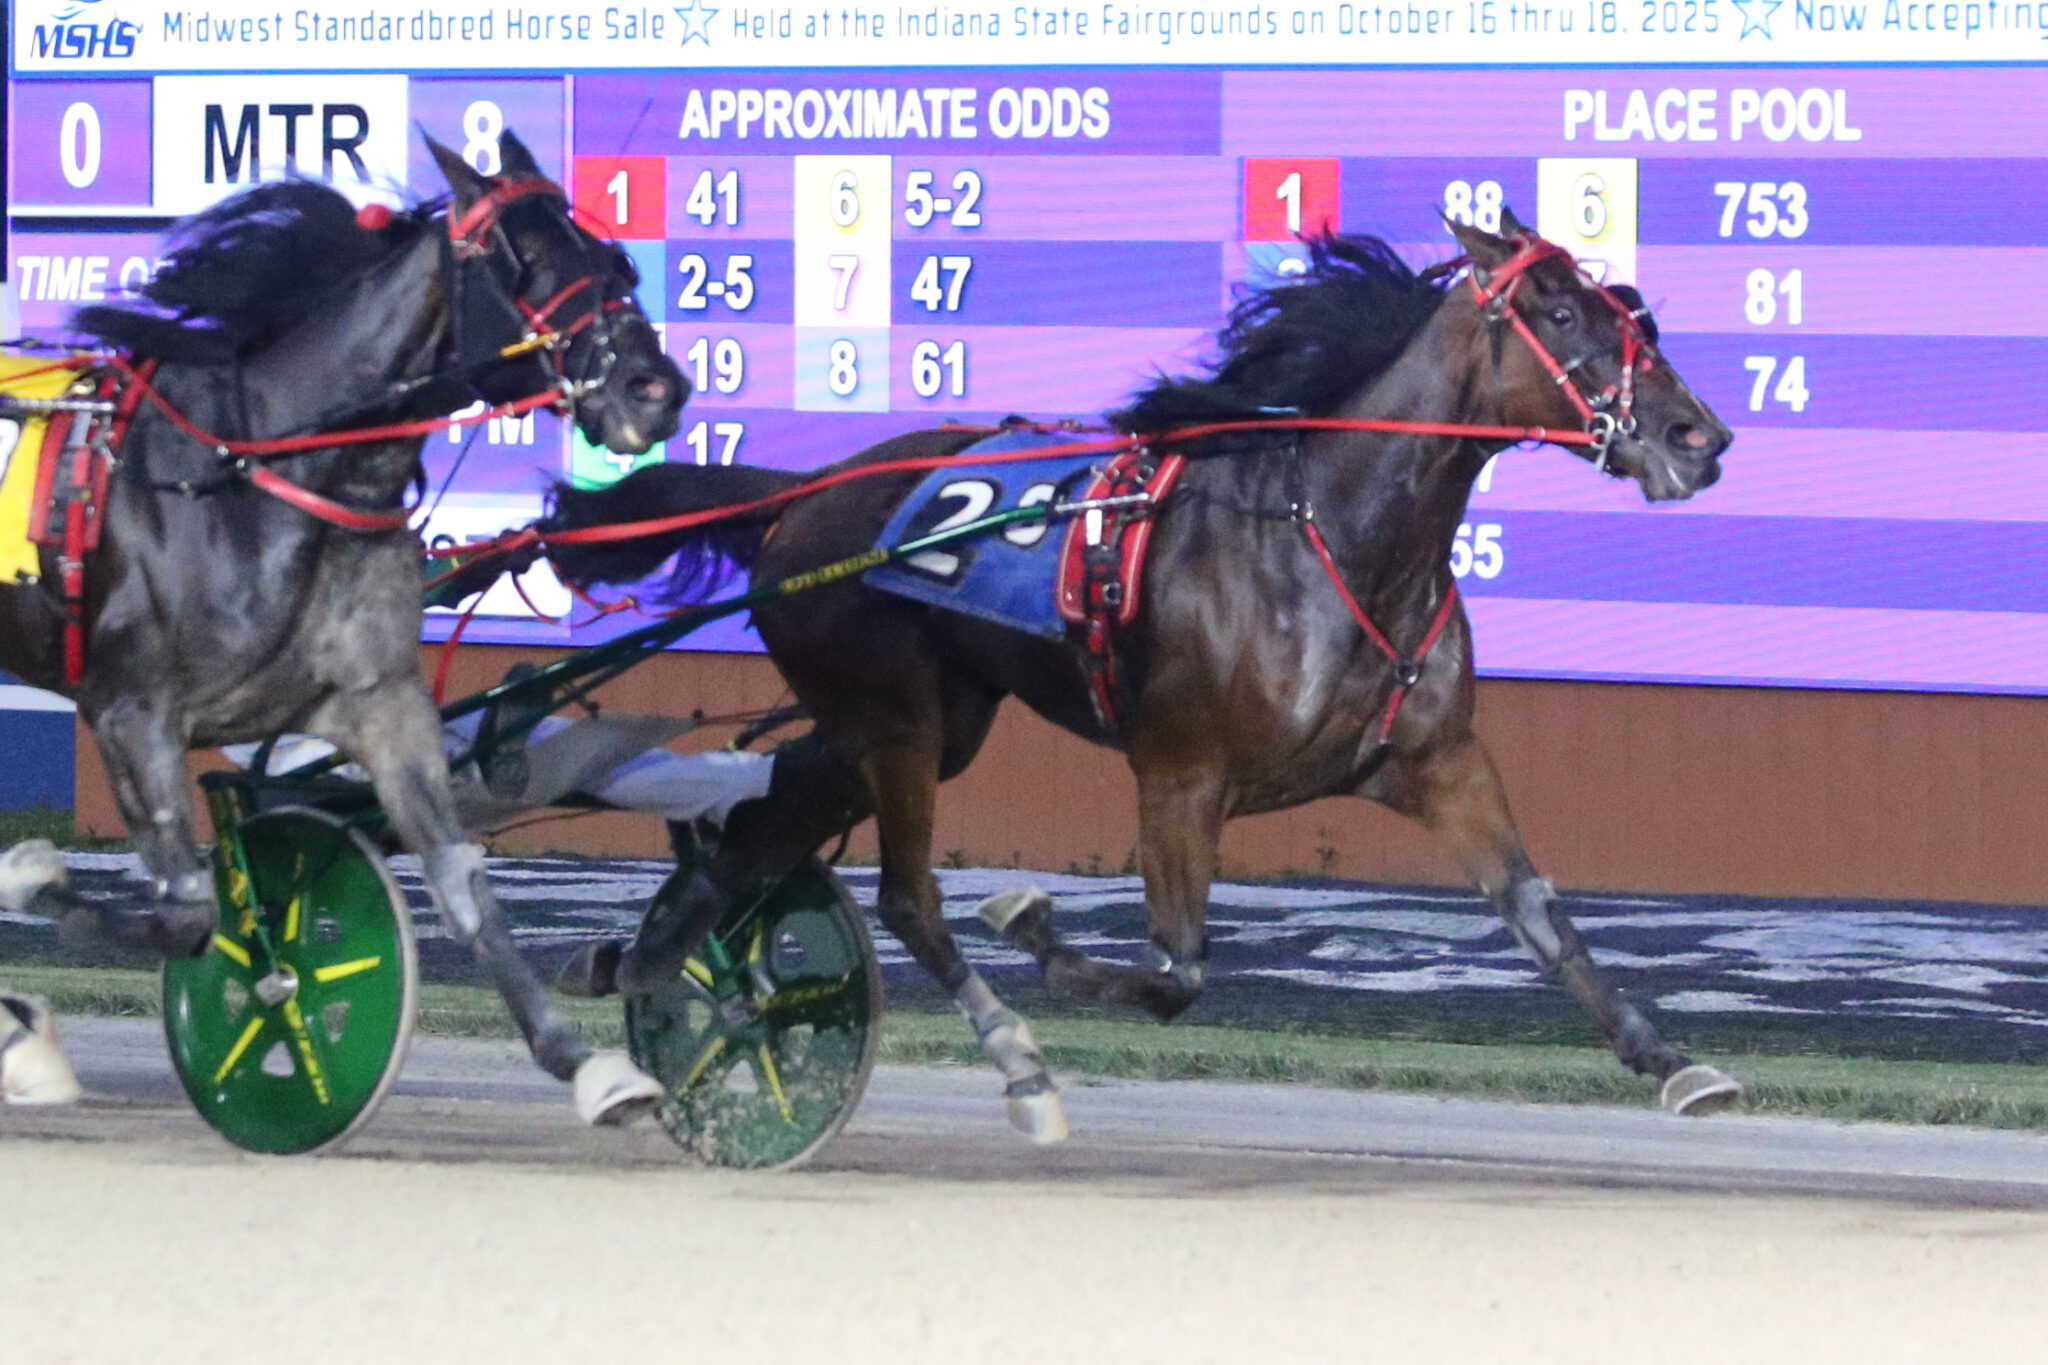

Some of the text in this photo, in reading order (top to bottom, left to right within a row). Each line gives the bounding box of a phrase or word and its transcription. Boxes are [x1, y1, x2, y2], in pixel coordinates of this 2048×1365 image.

[31, 22, 138, 58] MSHS
[164, 7, 664, 42] Midwest Standardbred Horse Sale
[733, 10, 793, 38] Held
[806, 10, 829, 37] at
[842, 8, 884, 37] the
[899, 8, 999, 36] Indiana
[1015, 7, 1088, 36] State
[1104, 4, 1277, 45] Fairgrounds
[1293, 11, 1323, 34] on
[1340, 4, 1453, 35] October
[1470, 1, 1496, 34] 16
[1511, 4, 1572, 32] thru
[1642, 0, 1718, 33] 2025
[1796, 0, 1866, 31] Now
[680, 88, 1109, 138] APPROXIMATE ODDS
[1564, 88, 1862, 142] PLACE POOL
[61, 101, 503, 187] 0 MTR 8
[608, 171, 980, 226] 1 41 6 5-2
[1278, 173, 1808, 237] 1 88 6 753
[17, 256, 109, 300] TIME
[679, 255, 970, 310] 2-5 7 47
[1744, 269, 1802, 325] 81
[688, 339, 963, 395] 19 8 61
[1745, 357, 1809, 411] 74
[688, 422, 742, 465] 17
